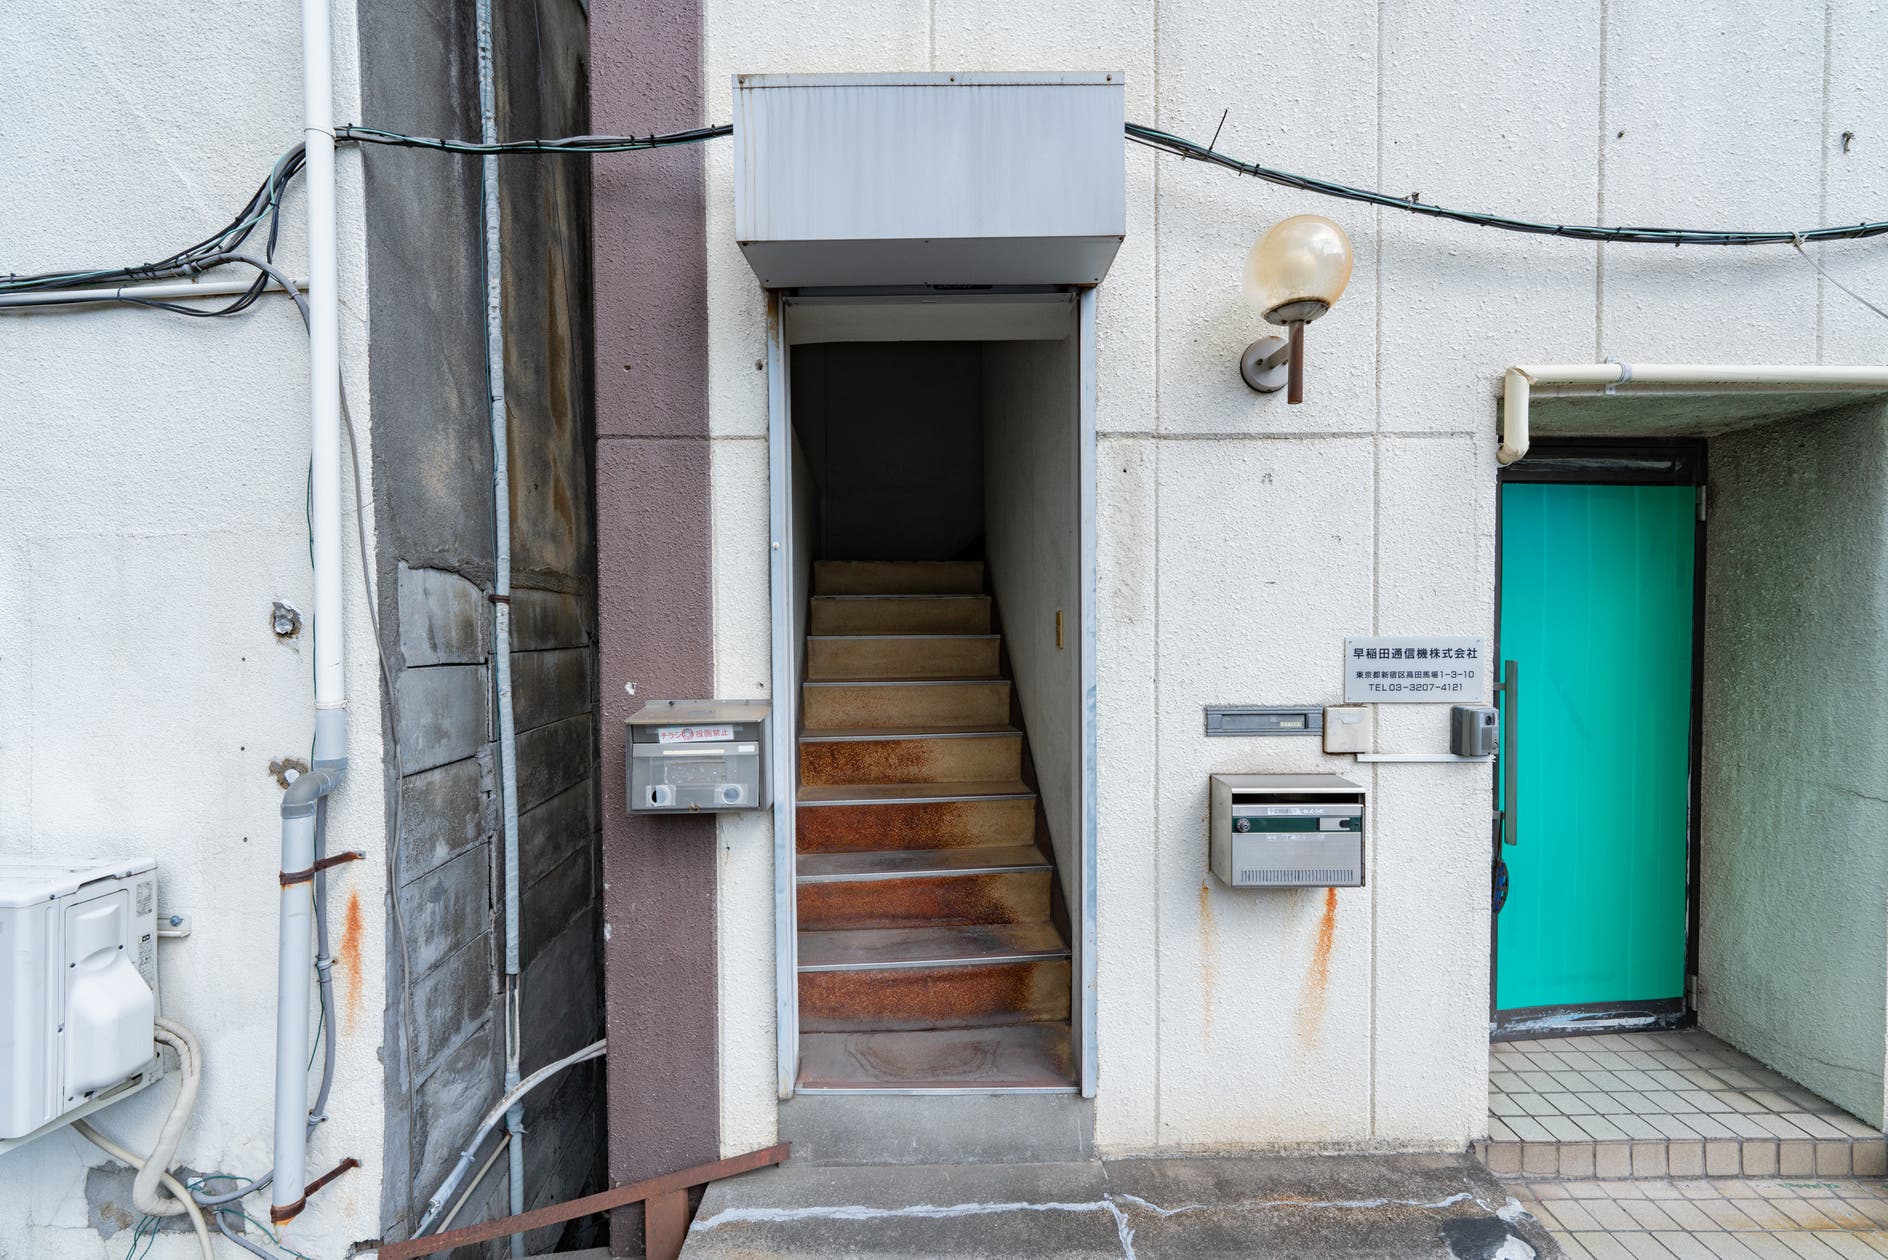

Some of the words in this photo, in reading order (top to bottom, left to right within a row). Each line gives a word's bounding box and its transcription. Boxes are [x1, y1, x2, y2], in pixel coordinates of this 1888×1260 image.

[1353, 648, 1478, 660] 早稲田通信機株式会社
